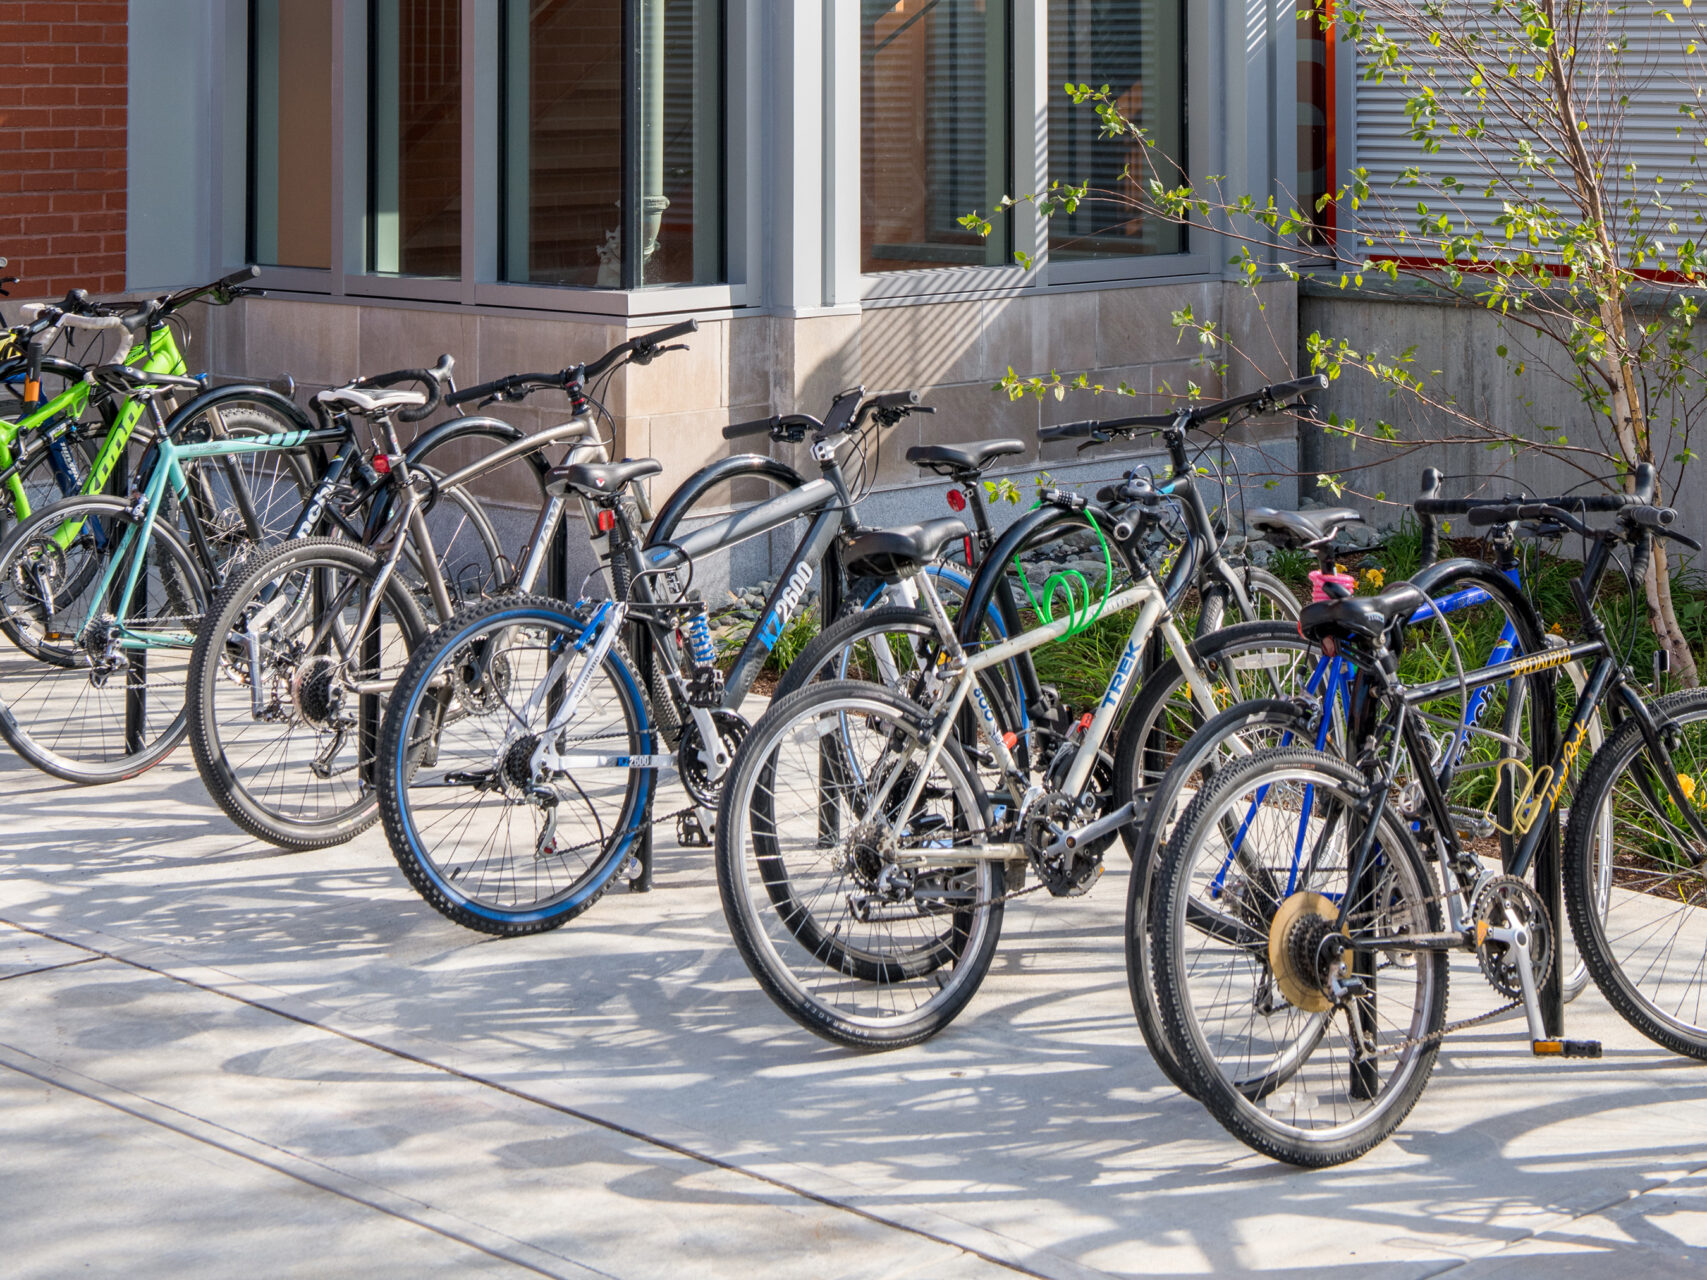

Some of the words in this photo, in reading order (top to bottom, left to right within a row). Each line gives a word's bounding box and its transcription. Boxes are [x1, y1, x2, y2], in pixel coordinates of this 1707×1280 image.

[253, 557, 296, 588] KENDA
[757, 560, 814, 652] KZ2600
[574, 655, 600, 699] SHIMANO
[1101, 639, 1141, 709] TREK
[1510, 648, 1572, 679] SPECIALIZED
[617, 756, 650, 767] KZ2600
[804, 1001, 869, 1038] BONTRAGER
